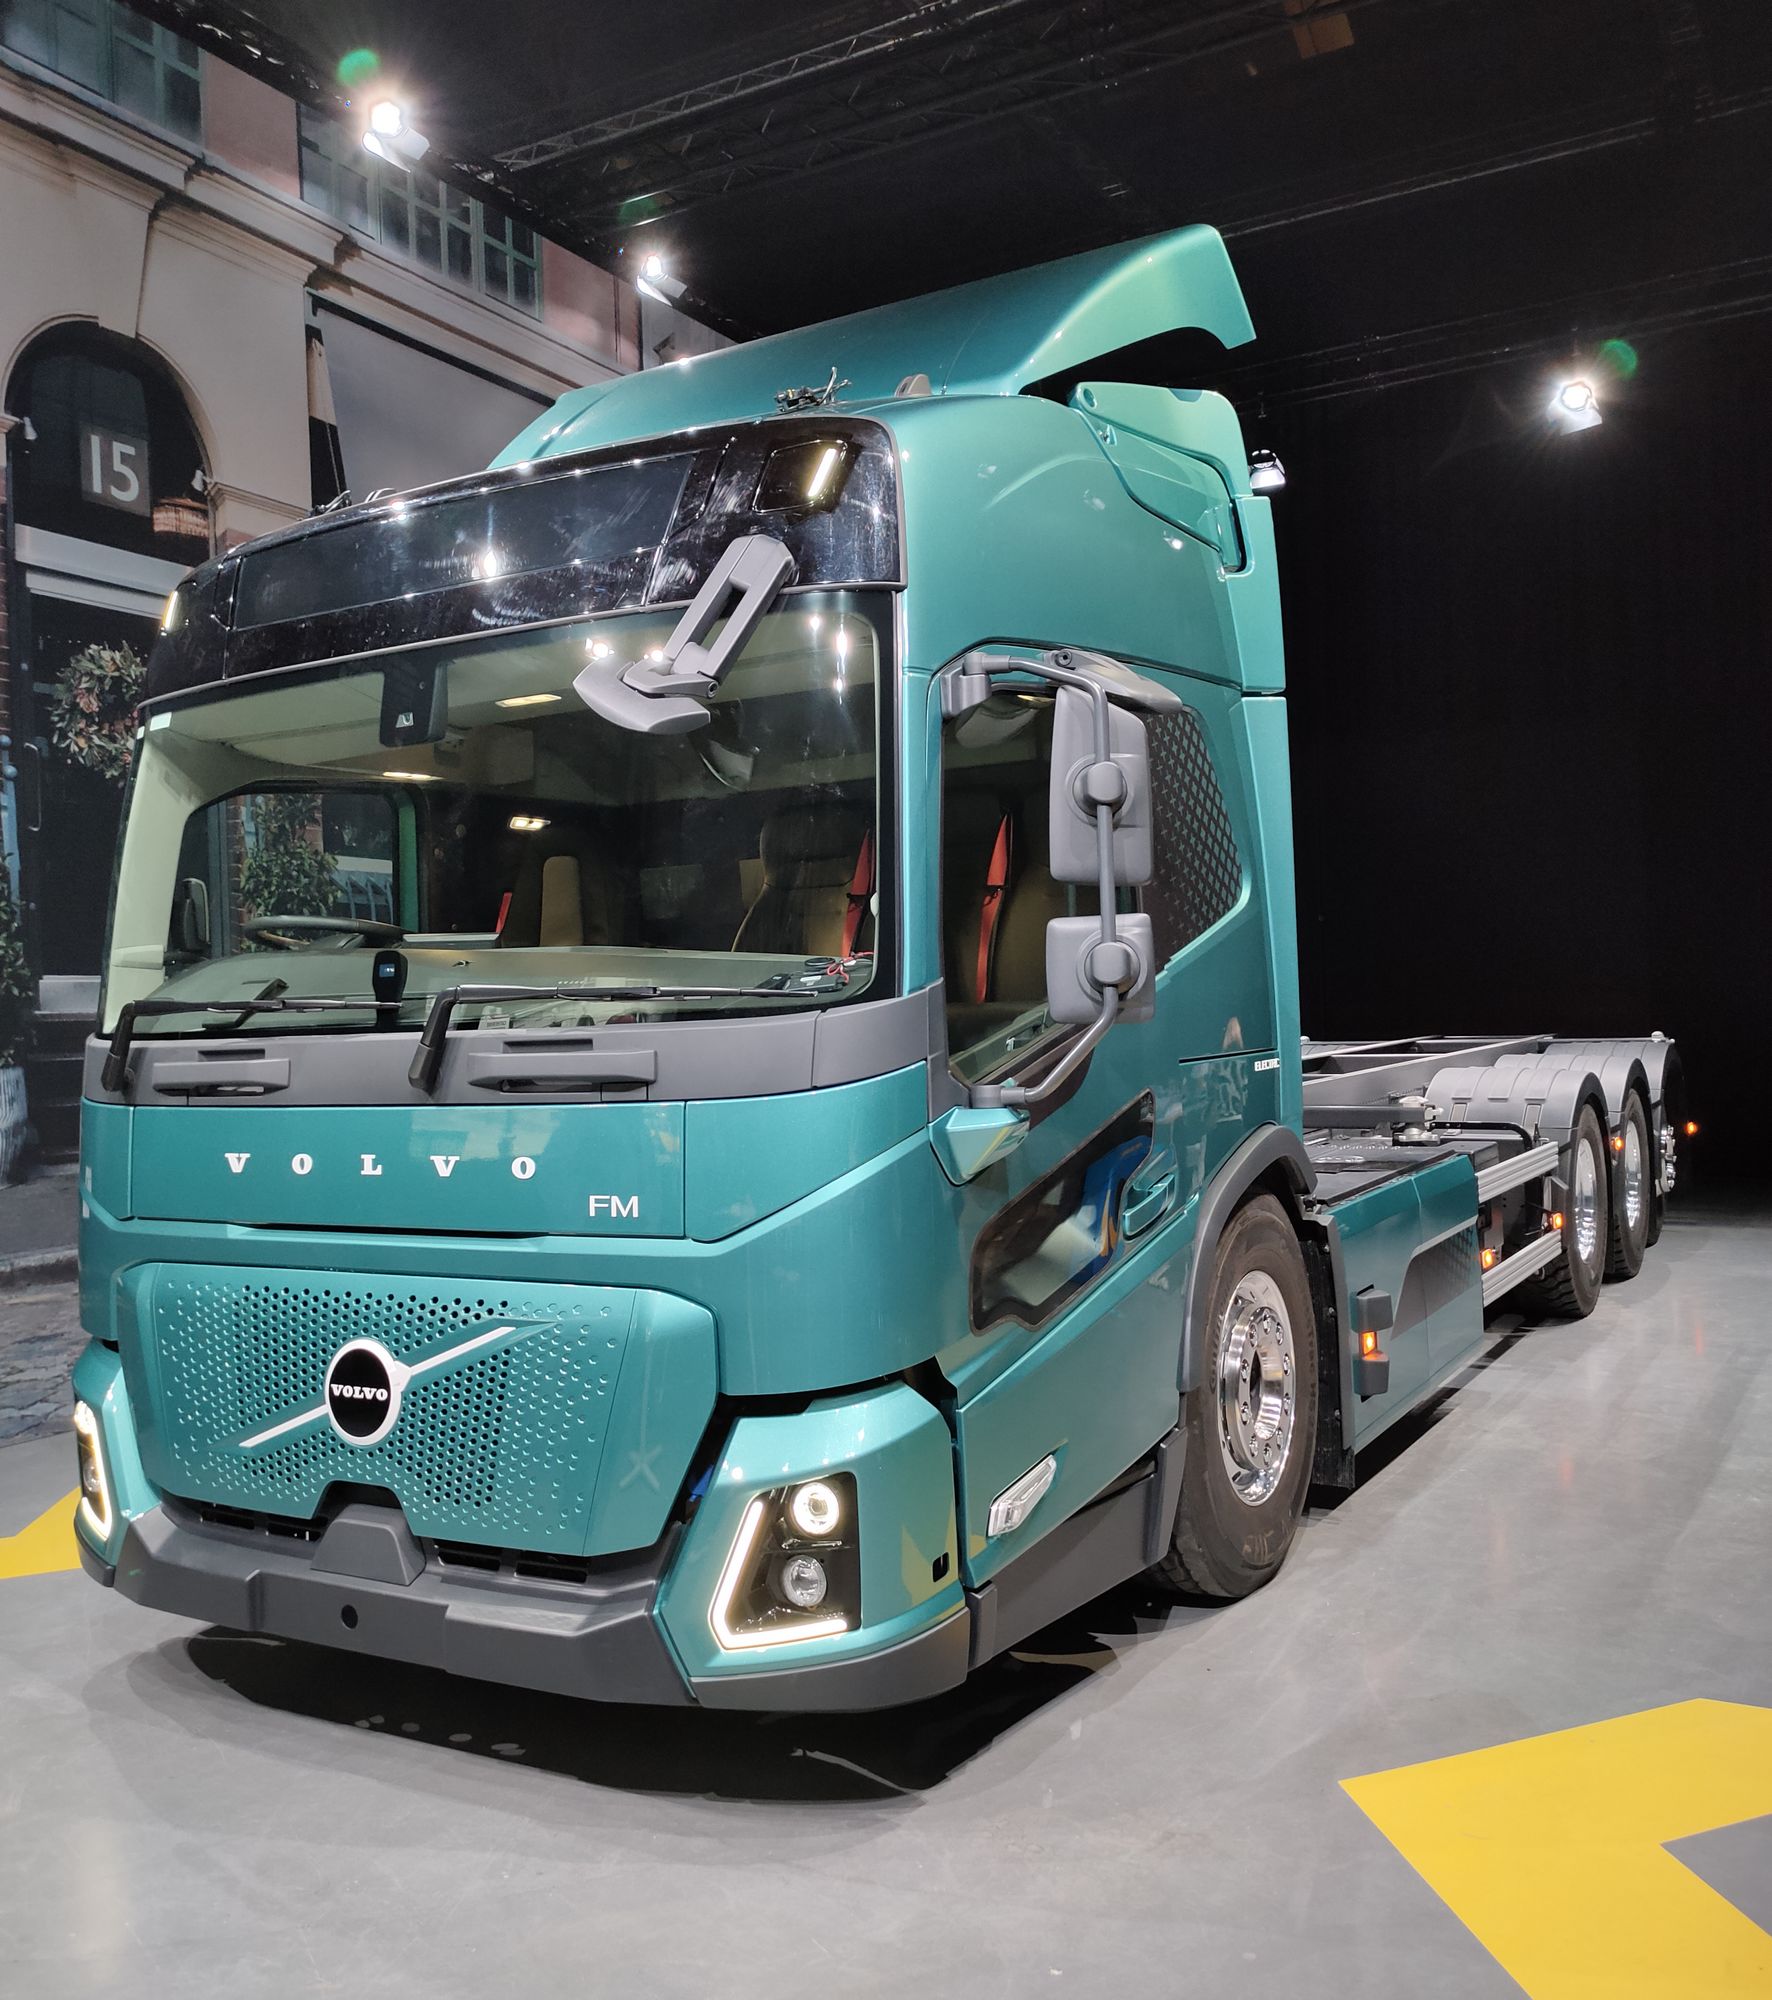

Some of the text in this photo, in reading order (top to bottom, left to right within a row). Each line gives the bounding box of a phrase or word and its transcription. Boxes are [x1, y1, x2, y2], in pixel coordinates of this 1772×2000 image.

[90, 434, 139, 502] 15
[224, 1152, 537, 1180] VOLVO
[589, 1195, 639, 1218] FM
[330, 1383, 389, 1402] VOLVO
